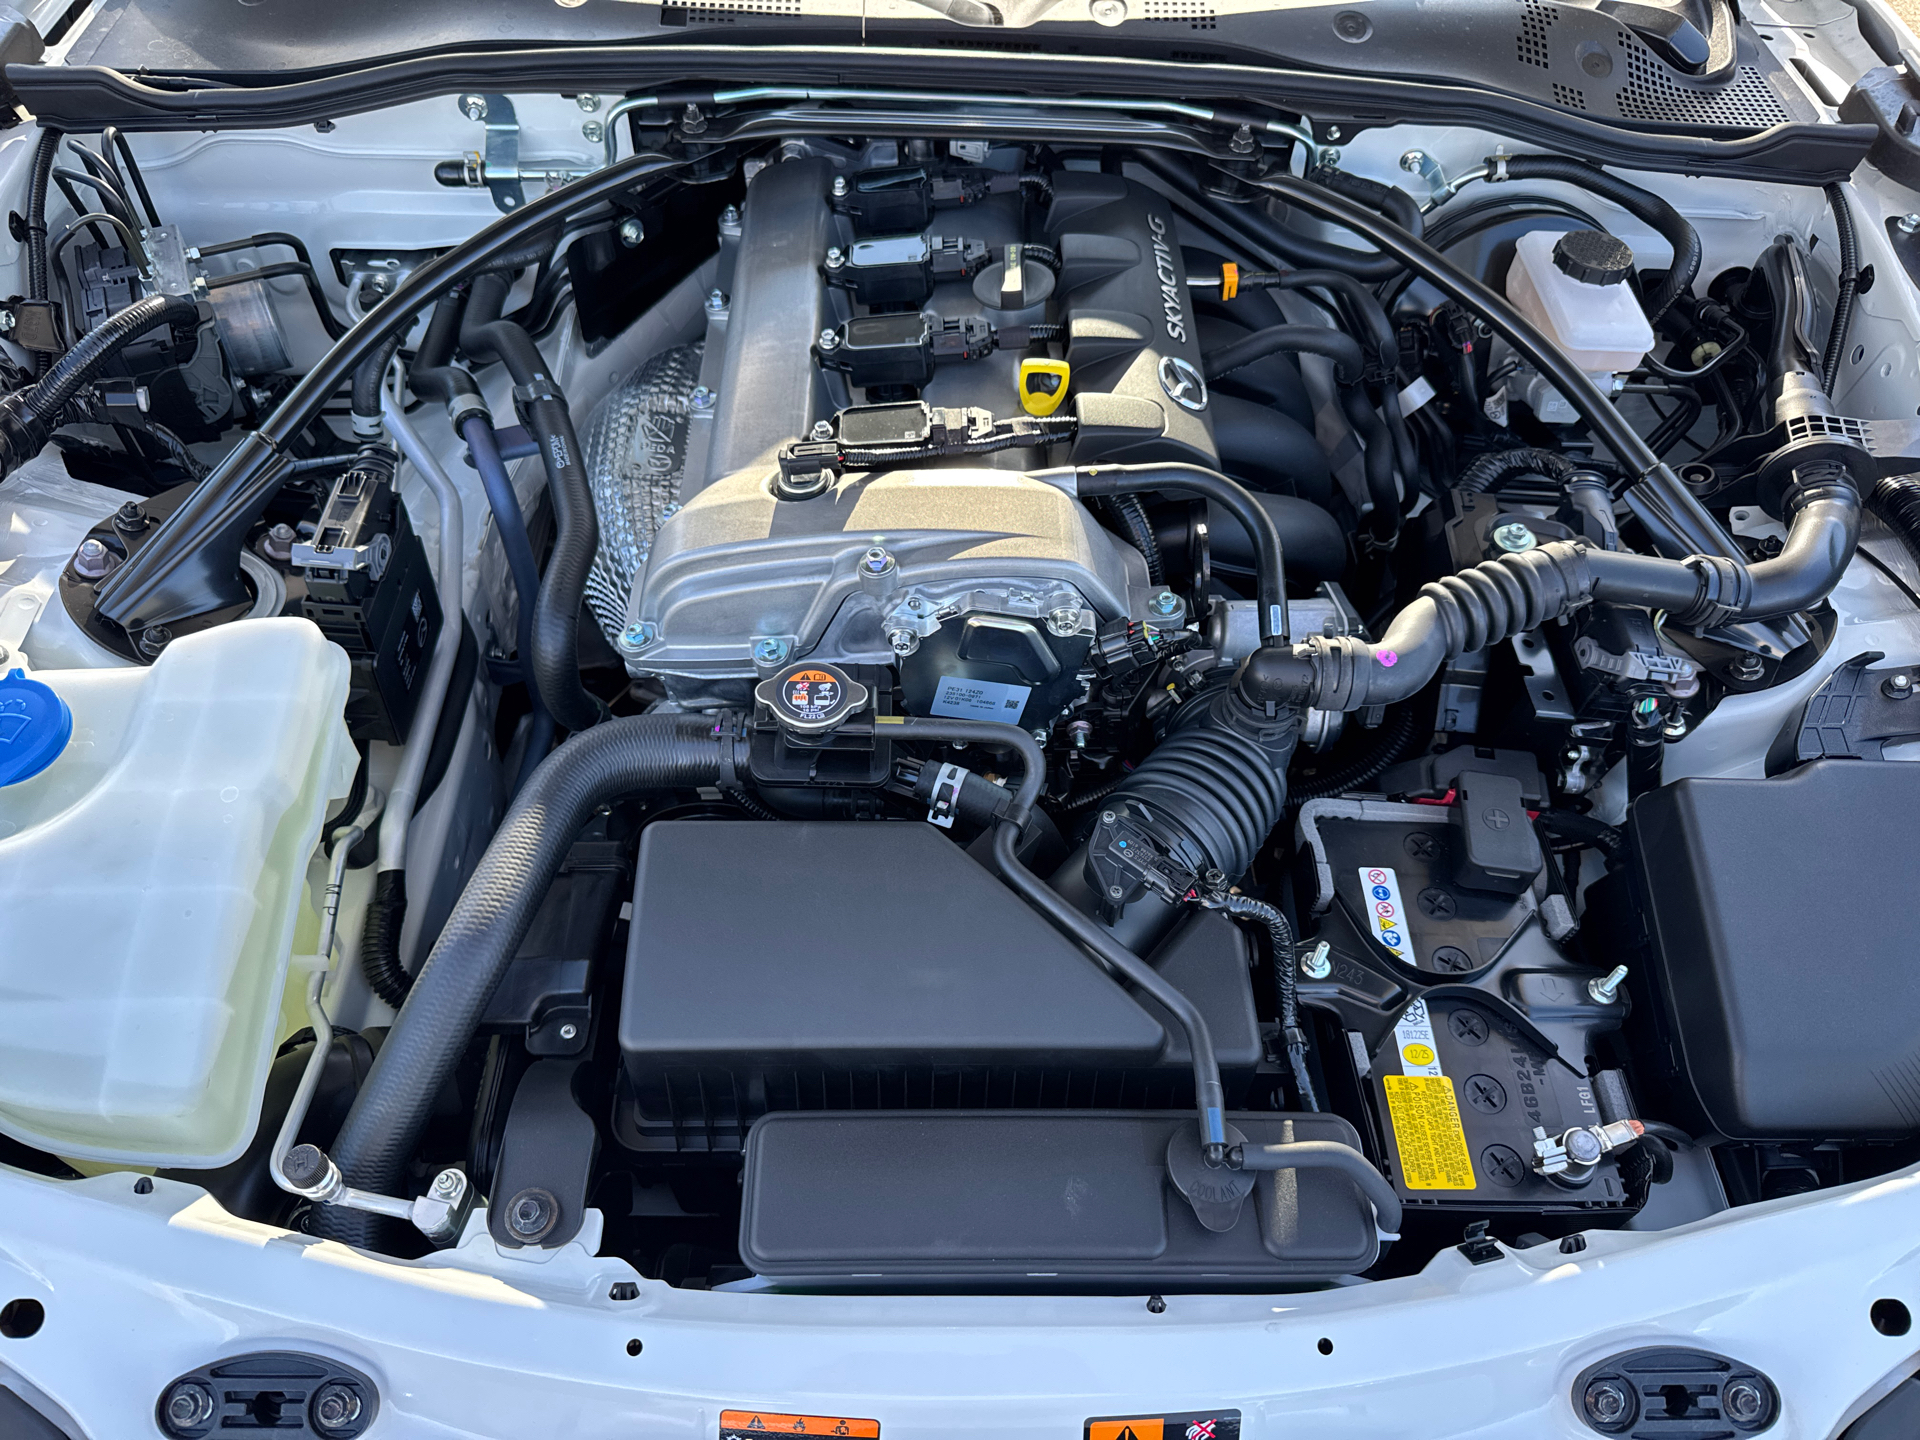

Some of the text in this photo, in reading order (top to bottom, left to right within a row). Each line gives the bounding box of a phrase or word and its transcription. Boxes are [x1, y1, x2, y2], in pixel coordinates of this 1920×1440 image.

[1147, 213, 1187, 343] SKYACTIV-G
[1410, 1049, 1430, 1059] 12/25
[1392, 1091, 1401, 1103] KEEP
[1395, 1104, 1403, 1114] OUT
[1580, 1086, 1595, 1113] LFG1
[1399, 1123, 1409, 1139] REACH
[1411, 1092, 1437, 1179] POISON CAUSES SEVERE BURNS
[1420, 1091, 1444, 1173] KEEP VENT CAPS TIGHT AND LEVEL
[1444, 1095, 1460, 1128] DANGER
[1452, 1130, 1465, 1156] EXPLOSIVE
[1459, 1158, 1469, 1175] GASES
[1405, 1148, 1416, 1172] CHILDREN
[1189, 1180, 1241, 1201] COOLANT
